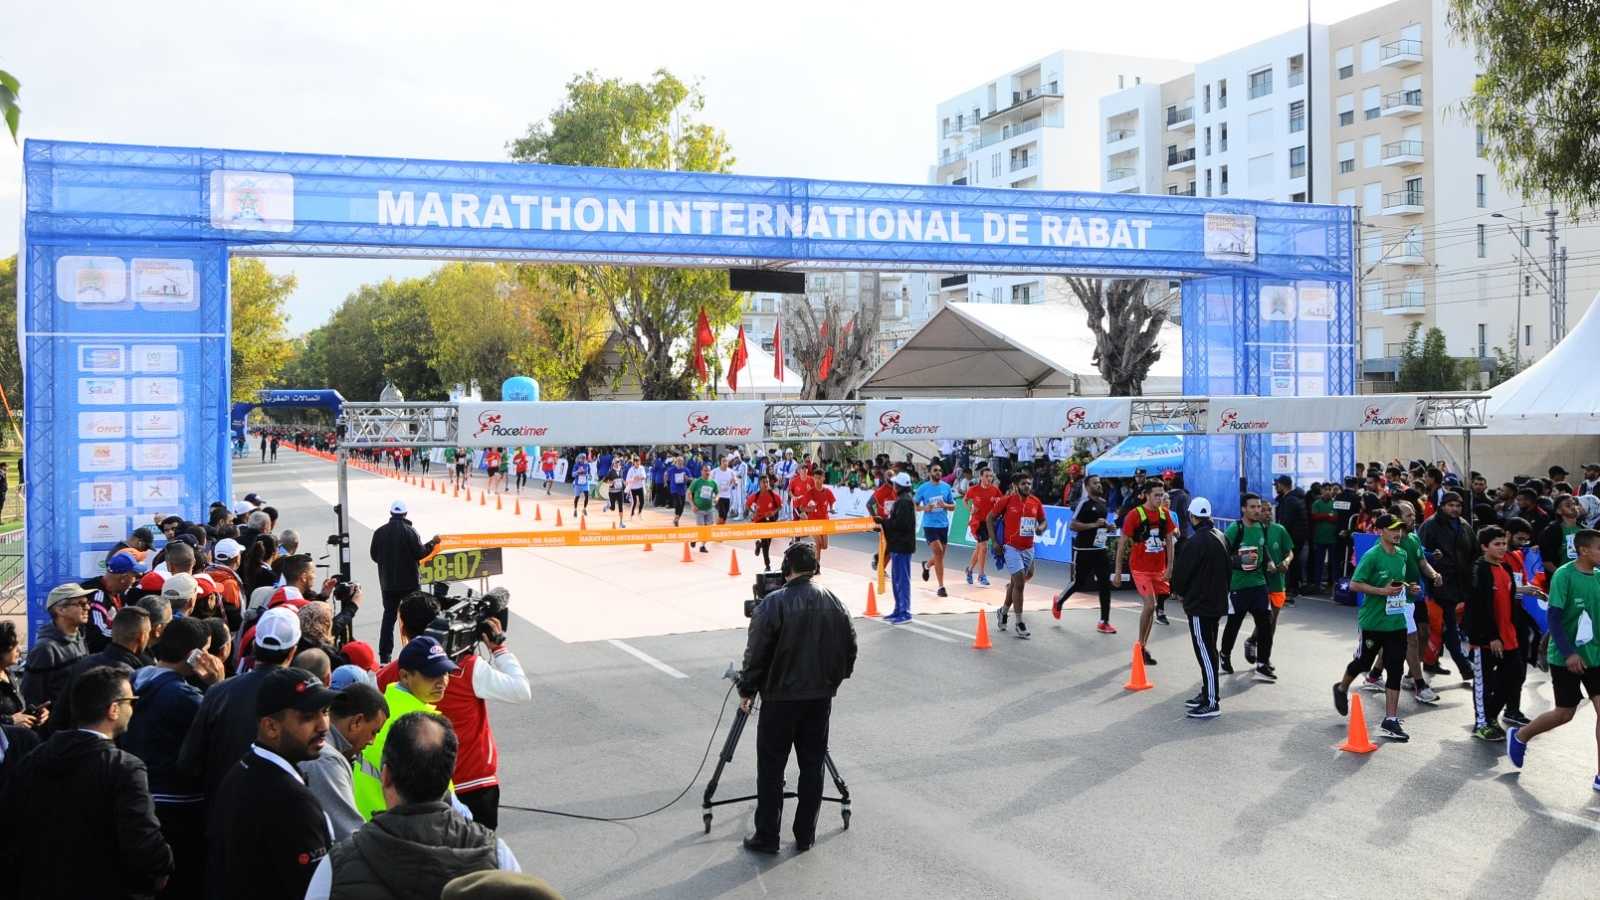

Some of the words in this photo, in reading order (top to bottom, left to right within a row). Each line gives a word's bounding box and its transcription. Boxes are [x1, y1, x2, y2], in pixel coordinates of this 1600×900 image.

[377, 190, 636, 233] MARATHON
[649, 199, 972, 244] INTERNATIONAL
[983, 212, 1029, 245] DE
[1040, 214, 1153, 251] RABAT
[1077, 418, 1121, 430] Racetimer
[1229, 419, 1270, 430] Racetimer
[1372, 416, 1409, 426] Racetimer
[491, 424, 548, 437] Racetimer
[700, 424, 752, 437] Racetimer
[891, 424, 940, 435] Racetimer
